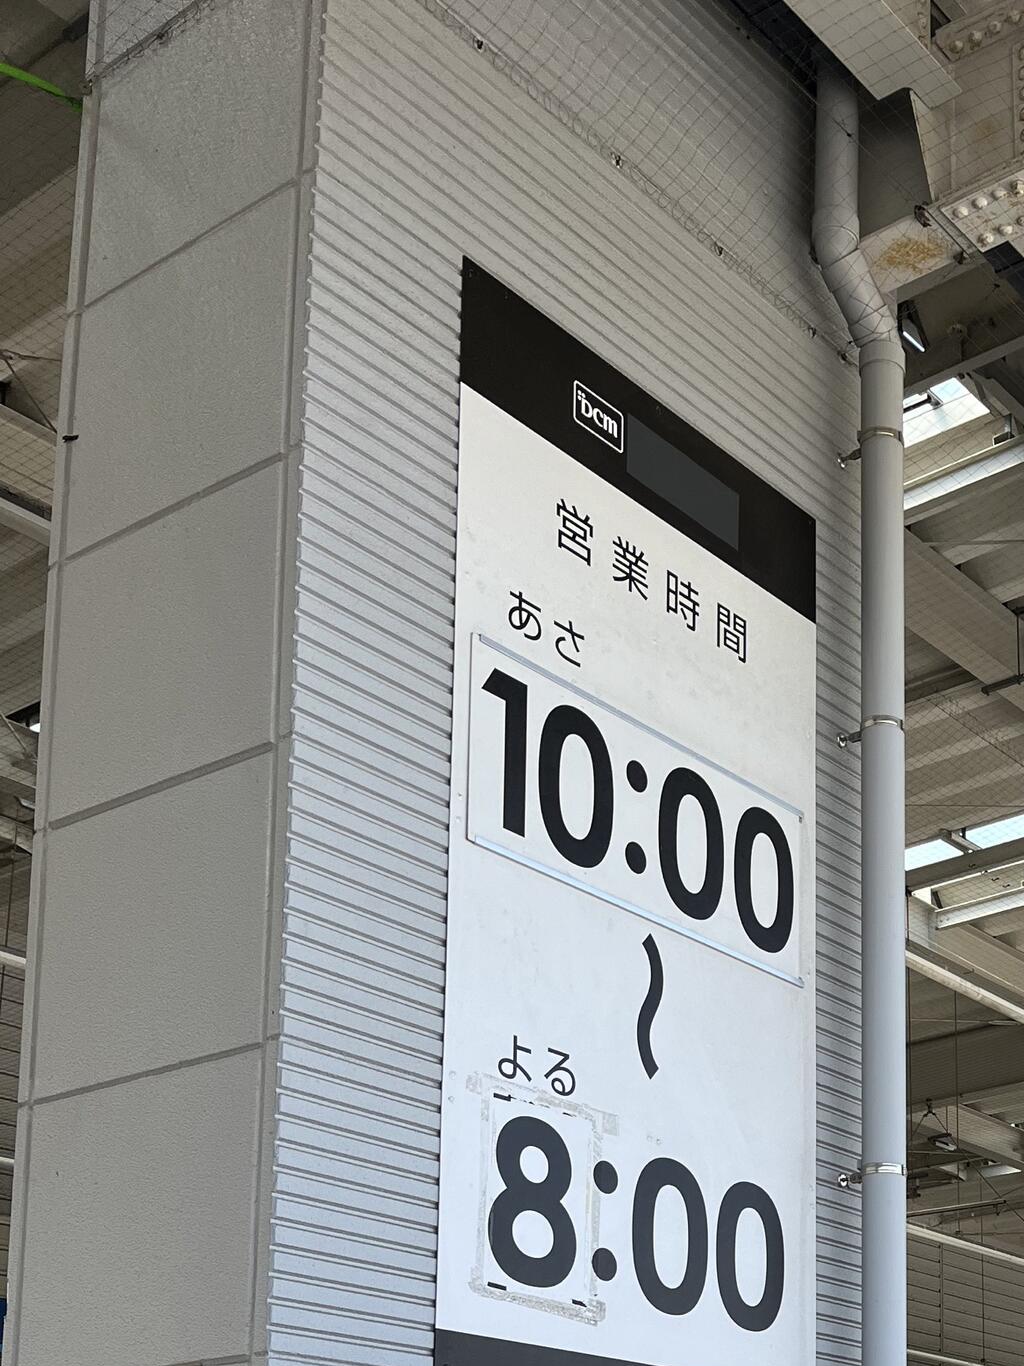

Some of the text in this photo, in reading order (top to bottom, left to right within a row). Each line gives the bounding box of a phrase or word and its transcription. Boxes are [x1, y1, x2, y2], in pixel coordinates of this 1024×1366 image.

[508, 590, 585, 667] あさ
[557, 499, 747, 664] 営業時間
[481, 668, 794, 954] 10:00
[497, 1034, 577, 1097] よる
[487, 1115, 785, 1333] 8:00
